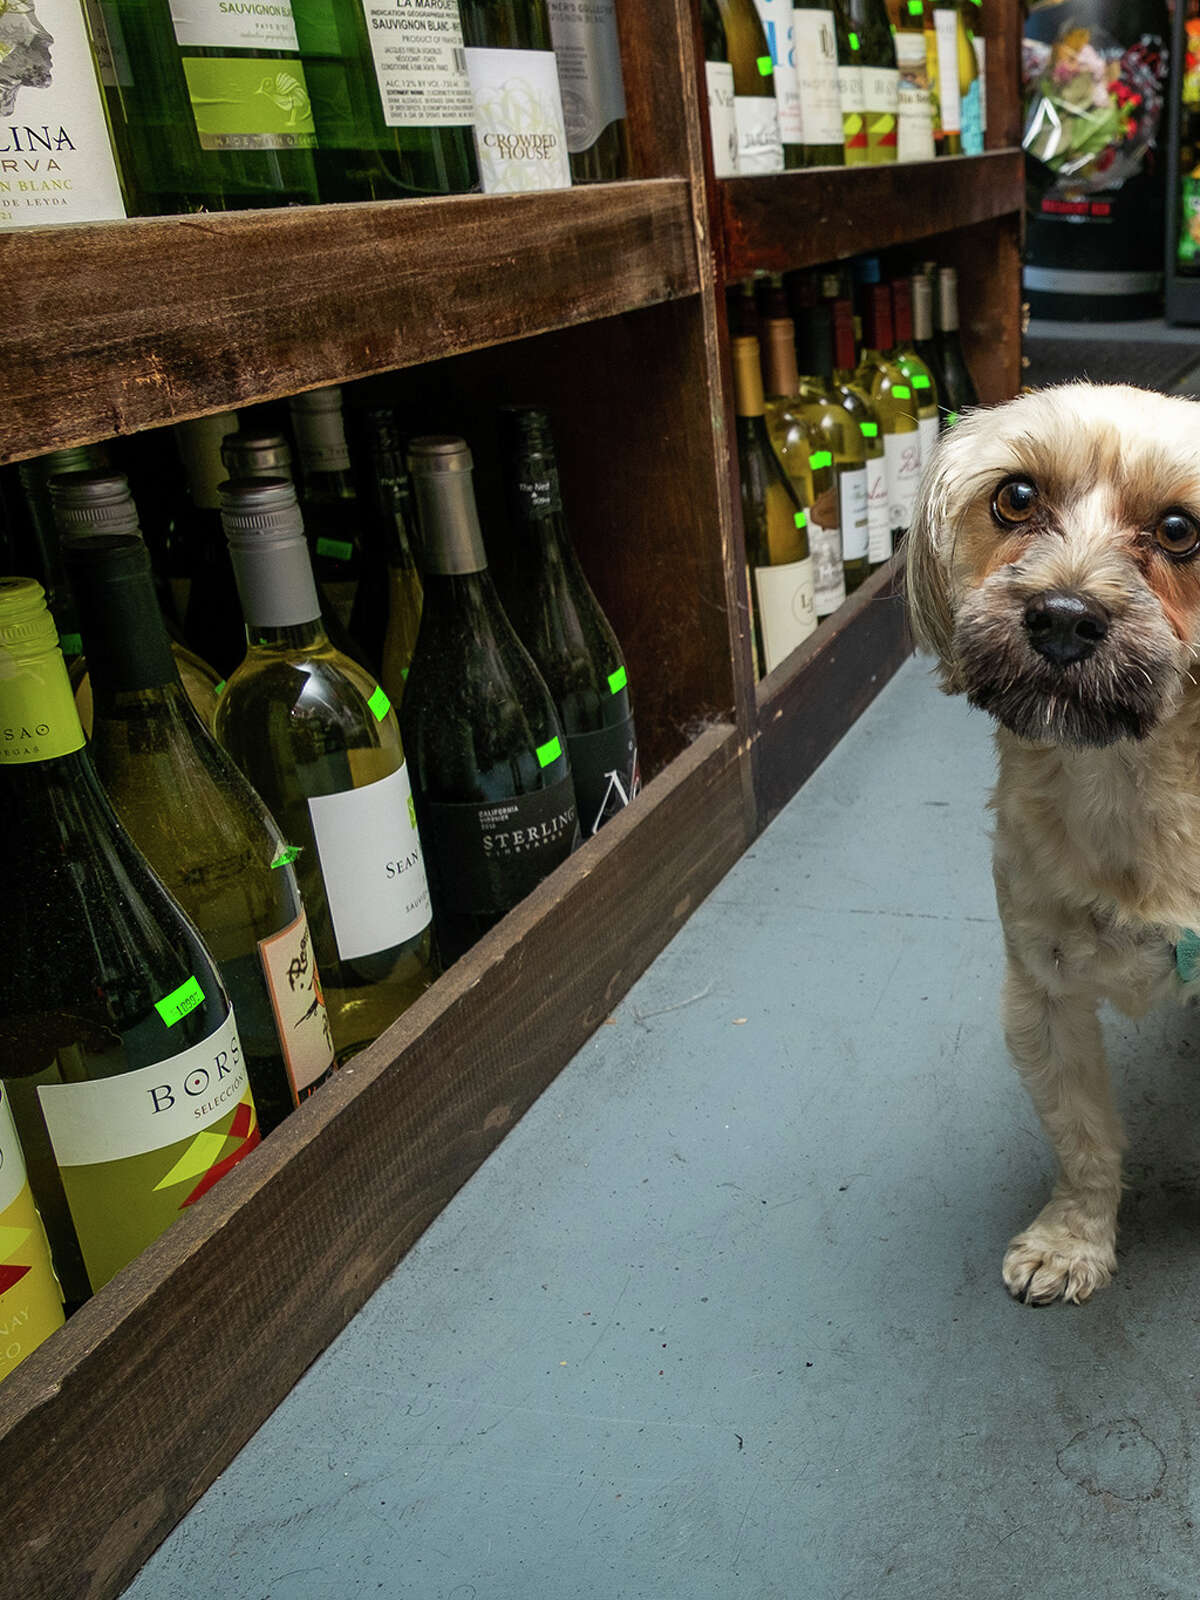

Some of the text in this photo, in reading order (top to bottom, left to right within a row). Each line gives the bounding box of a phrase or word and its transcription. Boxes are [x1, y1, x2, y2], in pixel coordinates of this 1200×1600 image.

[219, 2, 281, 17] SAUVIGNON
[372, 18, 427, 31] SAUVIGNON
[483, 133, 557, 148] CROWDED
[499, 145, 552, 160] HOUSE
[18, 180, 73, 192] BLANC
[478, 805, 519, 818] CALIFORNIA
[482, 804, 576, 851] STERLING
